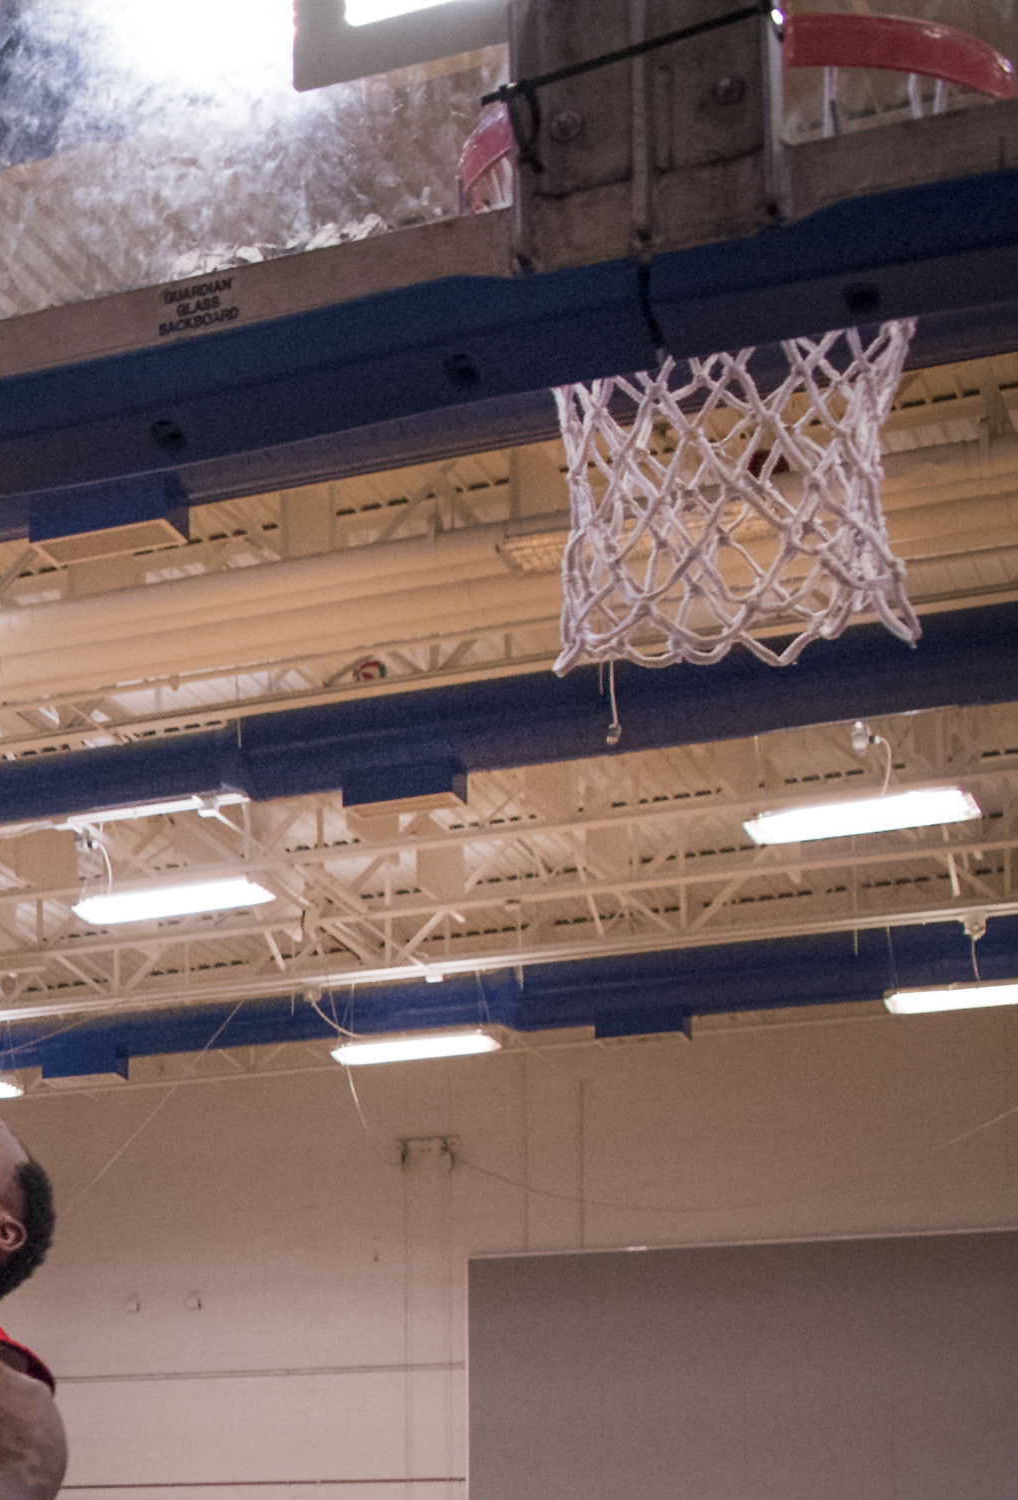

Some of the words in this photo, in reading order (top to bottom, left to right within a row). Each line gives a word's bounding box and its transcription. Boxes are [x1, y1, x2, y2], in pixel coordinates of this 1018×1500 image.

[163, 277, 234, 304] GUARDIAN
[176, 296, 220, 316] GLASS
[158, 306, 239, 336] BACKBOARD
